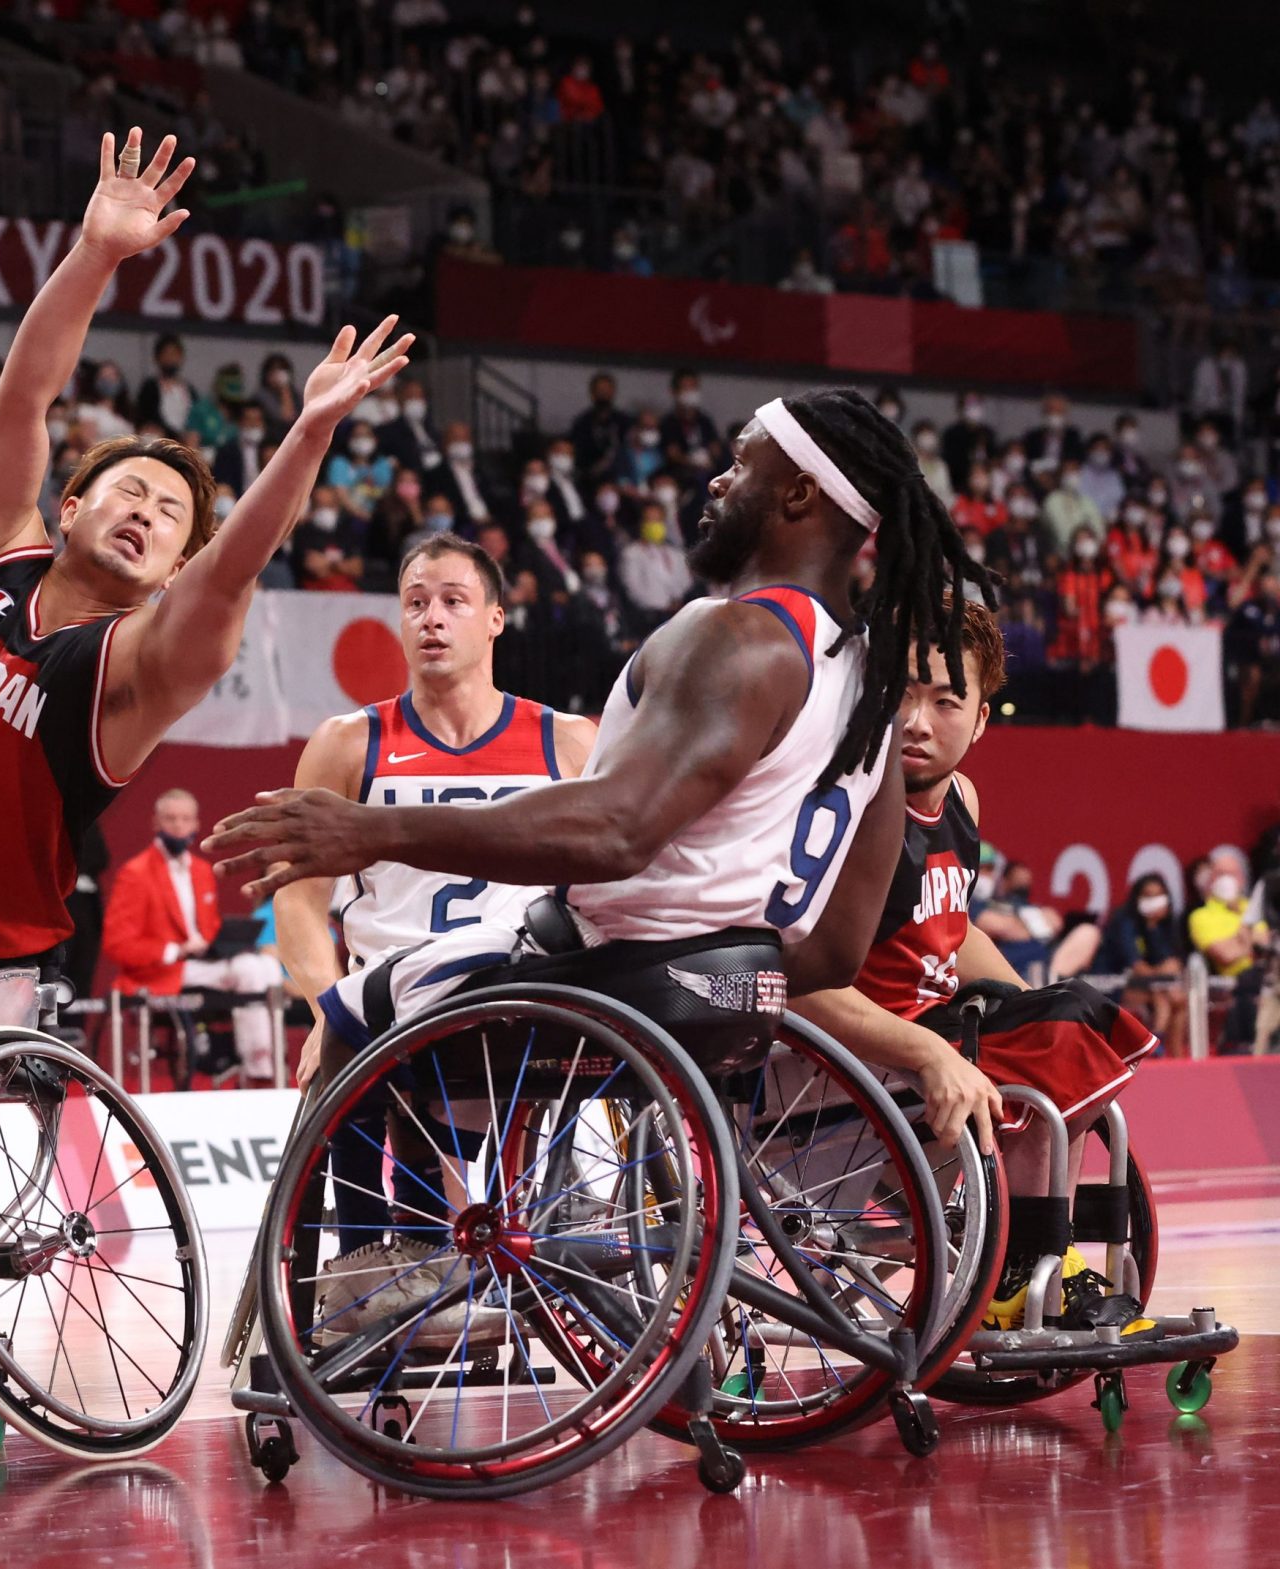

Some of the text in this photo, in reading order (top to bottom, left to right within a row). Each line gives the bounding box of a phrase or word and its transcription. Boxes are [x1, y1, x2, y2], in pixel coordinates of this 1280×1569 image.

[140, 233, 322, 326] 2020
[764, 783, 852, 930] 9
[429, 876, 489, 934] 2
[913, 866, 976, 926] JAPAN
